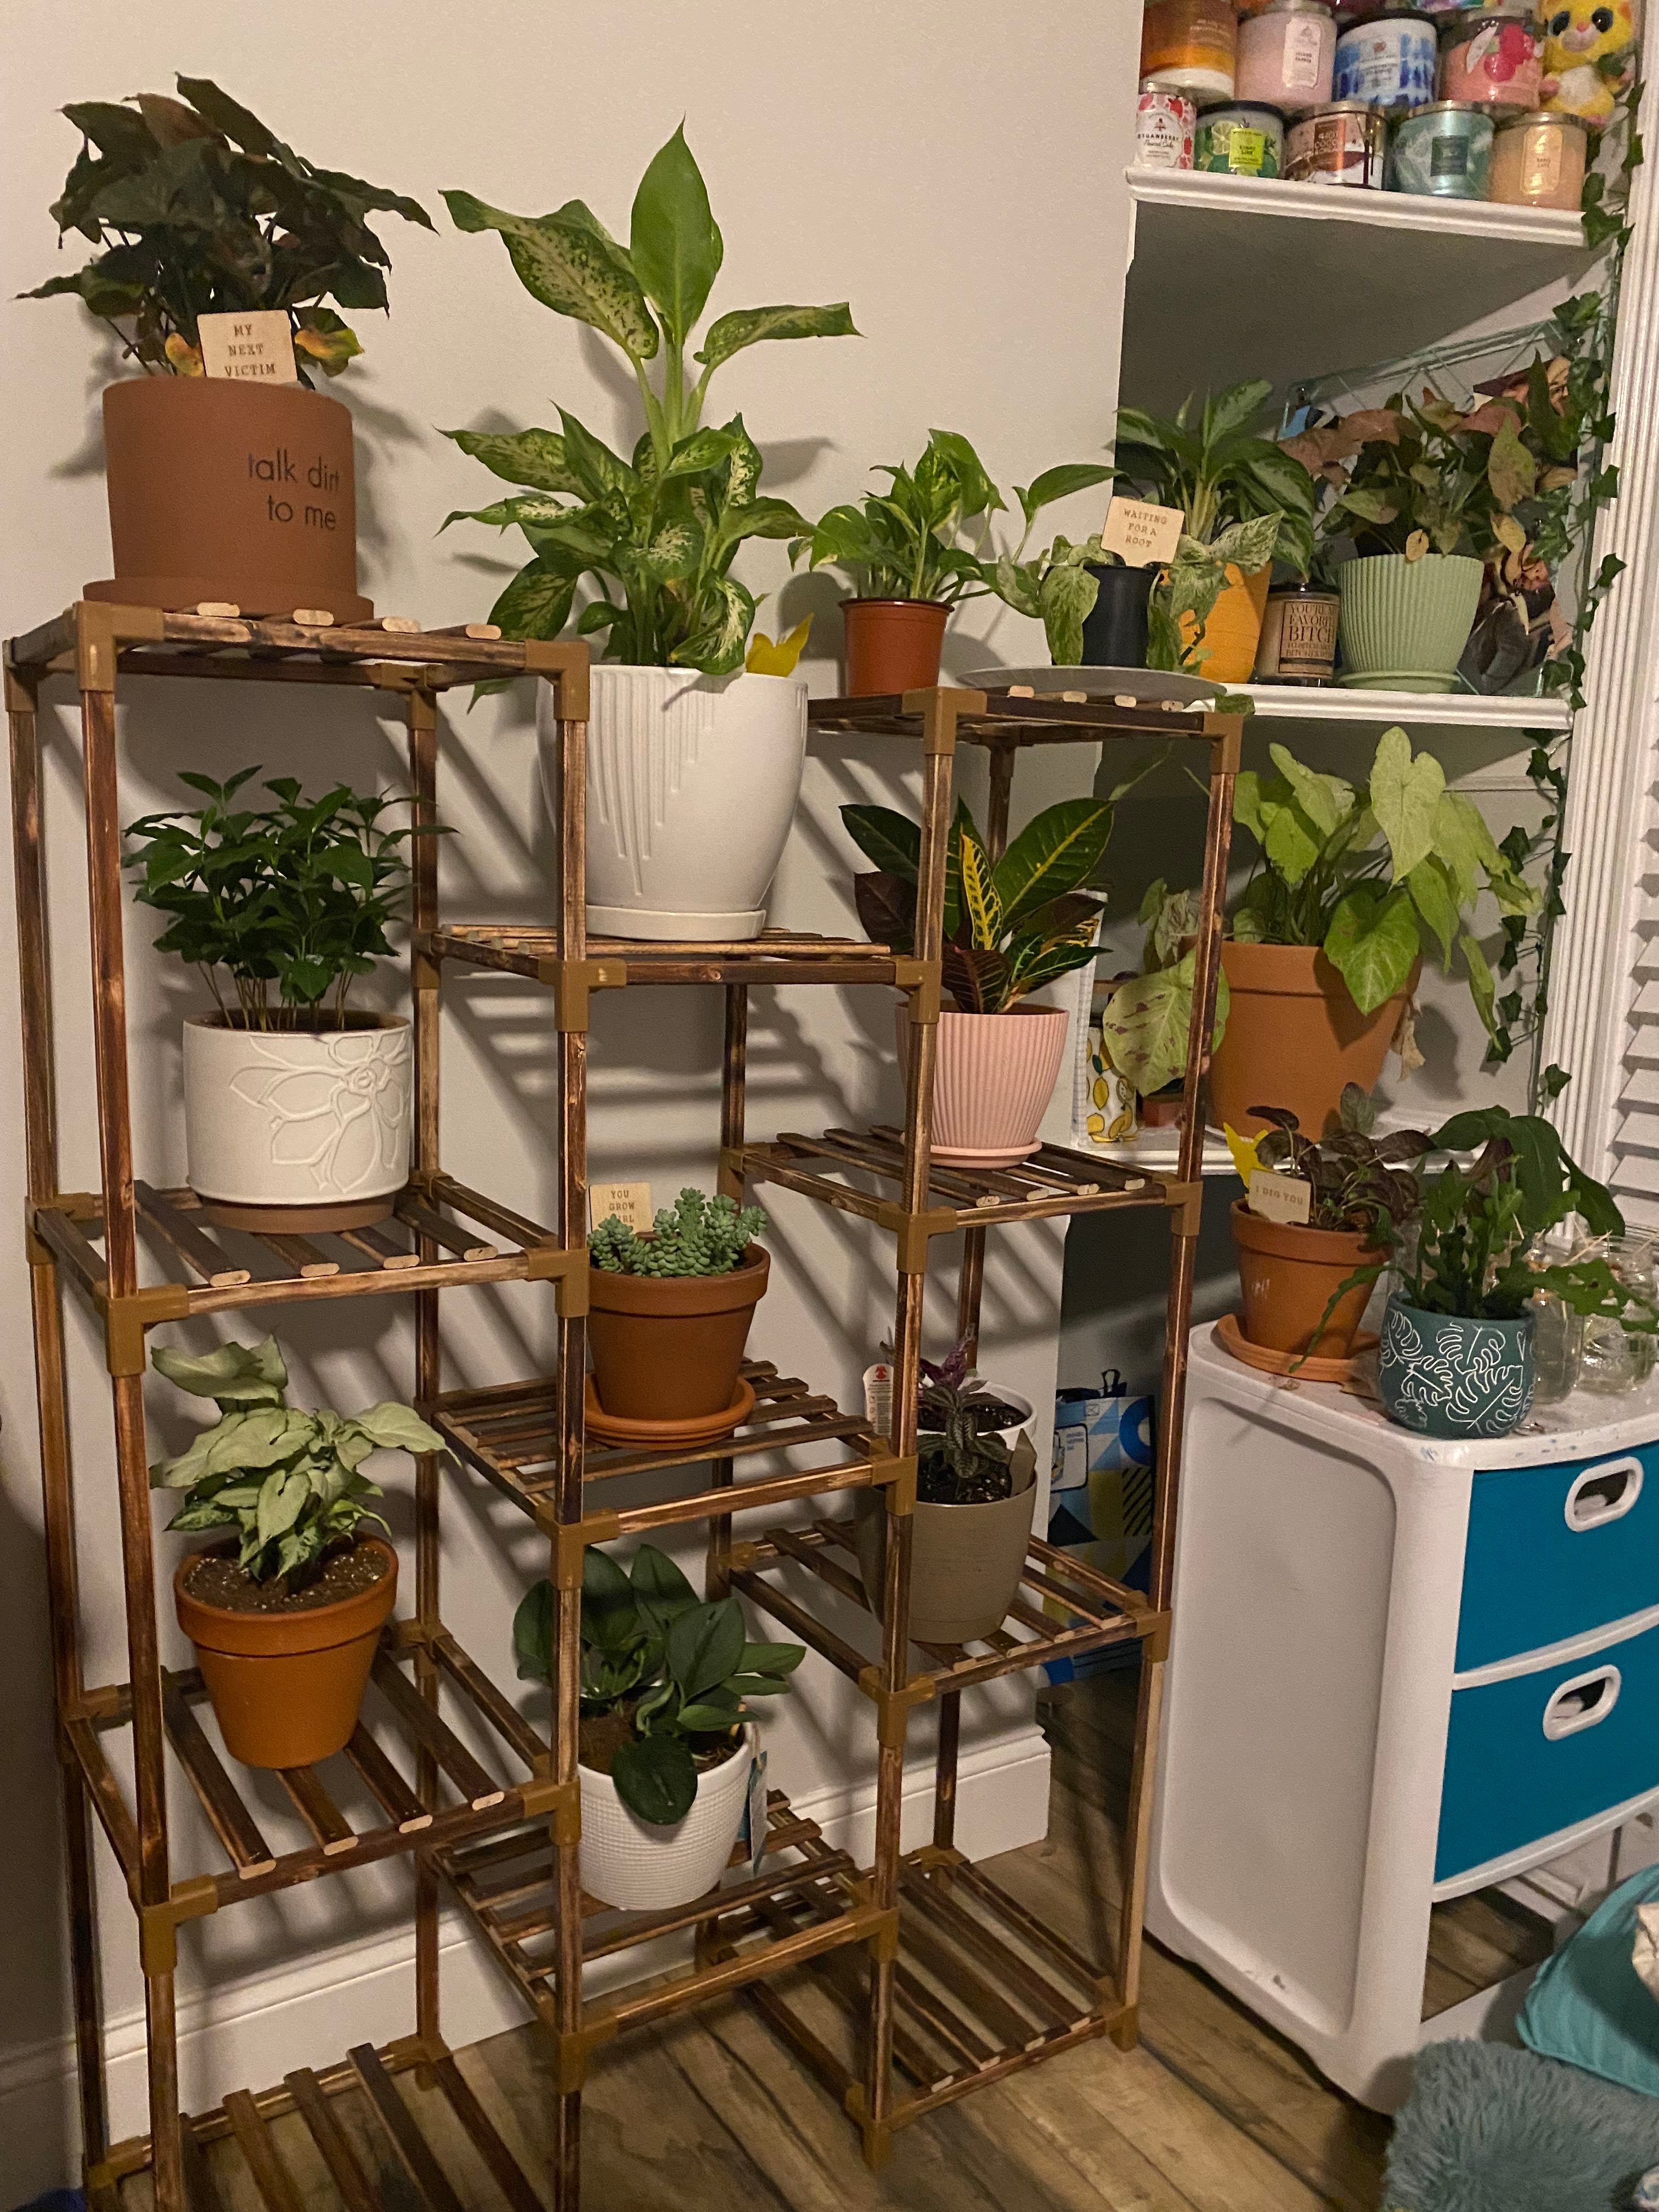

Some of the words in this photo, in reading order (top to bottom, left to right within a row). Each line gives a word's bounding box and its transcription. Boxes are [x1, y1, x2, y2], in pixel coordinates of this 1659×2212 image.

[234, 324, 252, 337] MY
[228, 343, 263, 357] NEXT
[224, 363, 275, 377] VICTIM
[267, 494, 293, 522] to
[305, 506, 336, 531] me
[1124, 508, 1169, 525] WAITING
[1128, 522, 1148, 534] FOR
[1150, 527, 1157, 537] A
[1125, 535, 1153, 548] ROOT
[611, 1189, 629, 1199] YOU
[1255, 1185, 1259, 1193] I
[1283, 1192, 1303, 1205] YOU
[609, 1202, 635, 1211] GROW
